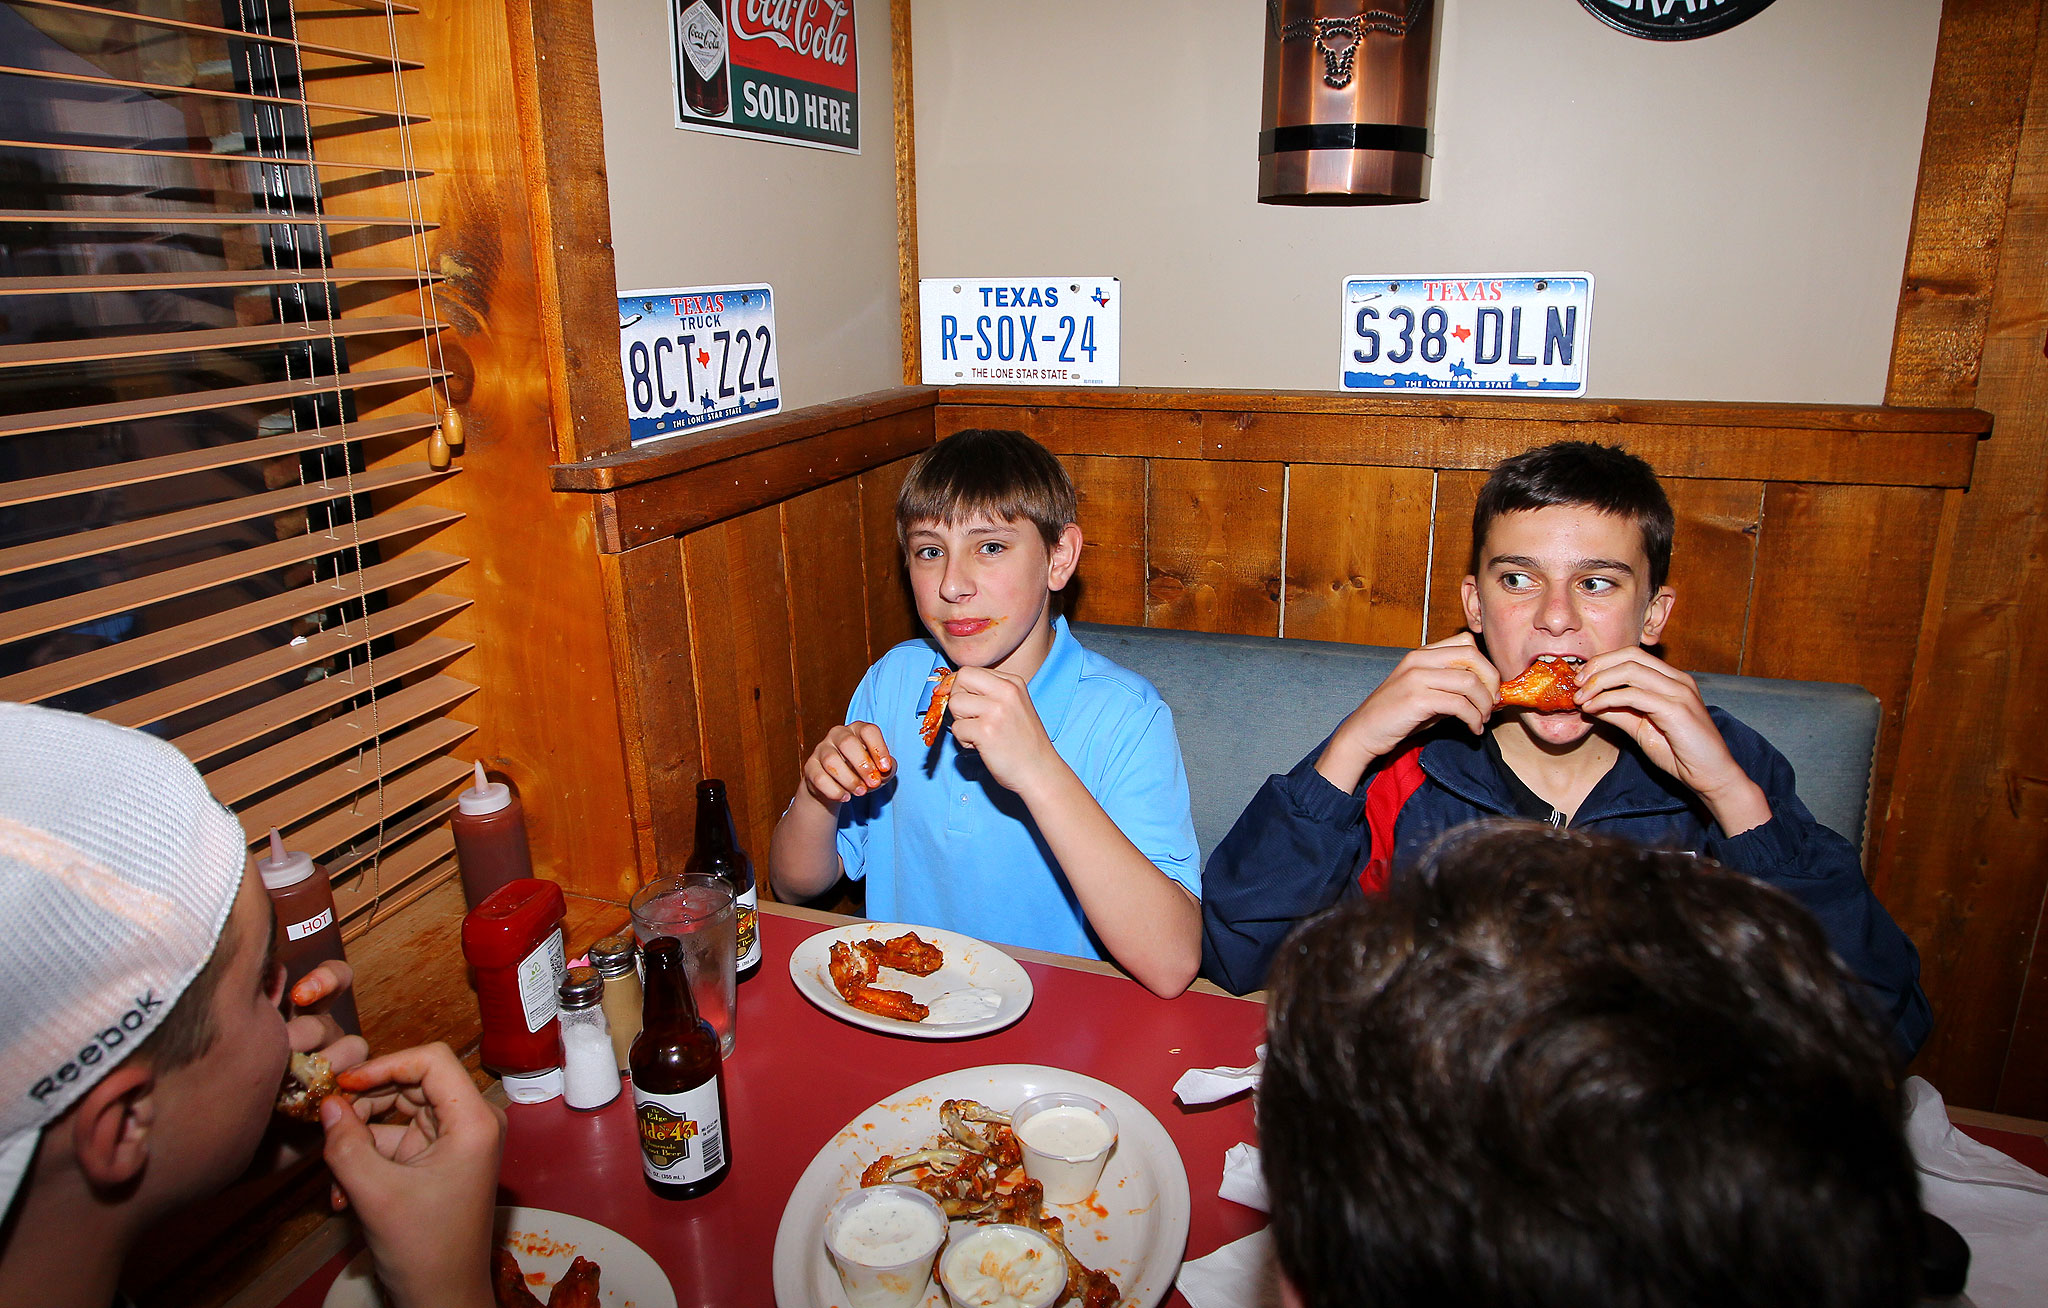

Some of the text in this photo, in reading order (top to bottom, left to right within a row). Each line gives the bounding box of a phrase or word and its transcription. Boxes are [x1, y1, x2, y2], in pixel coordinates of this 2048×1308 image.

[742, 80, 851, 135] SOLD HERE
[979, 287, 1059, 307] TEXAS
[1423, 281, 1502, 302] TEXAS
[671, 295, 724, 316] TEXAS
[680, 315, 721, 331] TRUCK
[941, 315, 1097, 363] R-SOX-24
[1353, 305, 1577, 366] S38 DLN
[629, 325, 775, 413] 8CT Z22
[971, 367, 1068, 380] THE LONE STAR STATE
[1405, 380, 1512, 389] THE LONE STAR STATE
[672, 407, 742, 429] THE LONE STAR STATE
[302, 913, 328, 934] HOT
[29, 989, 163, 1102] Reebok
[647, 1112, 668, 1122] Edge
[669, 1120, 695, 1141] 43
